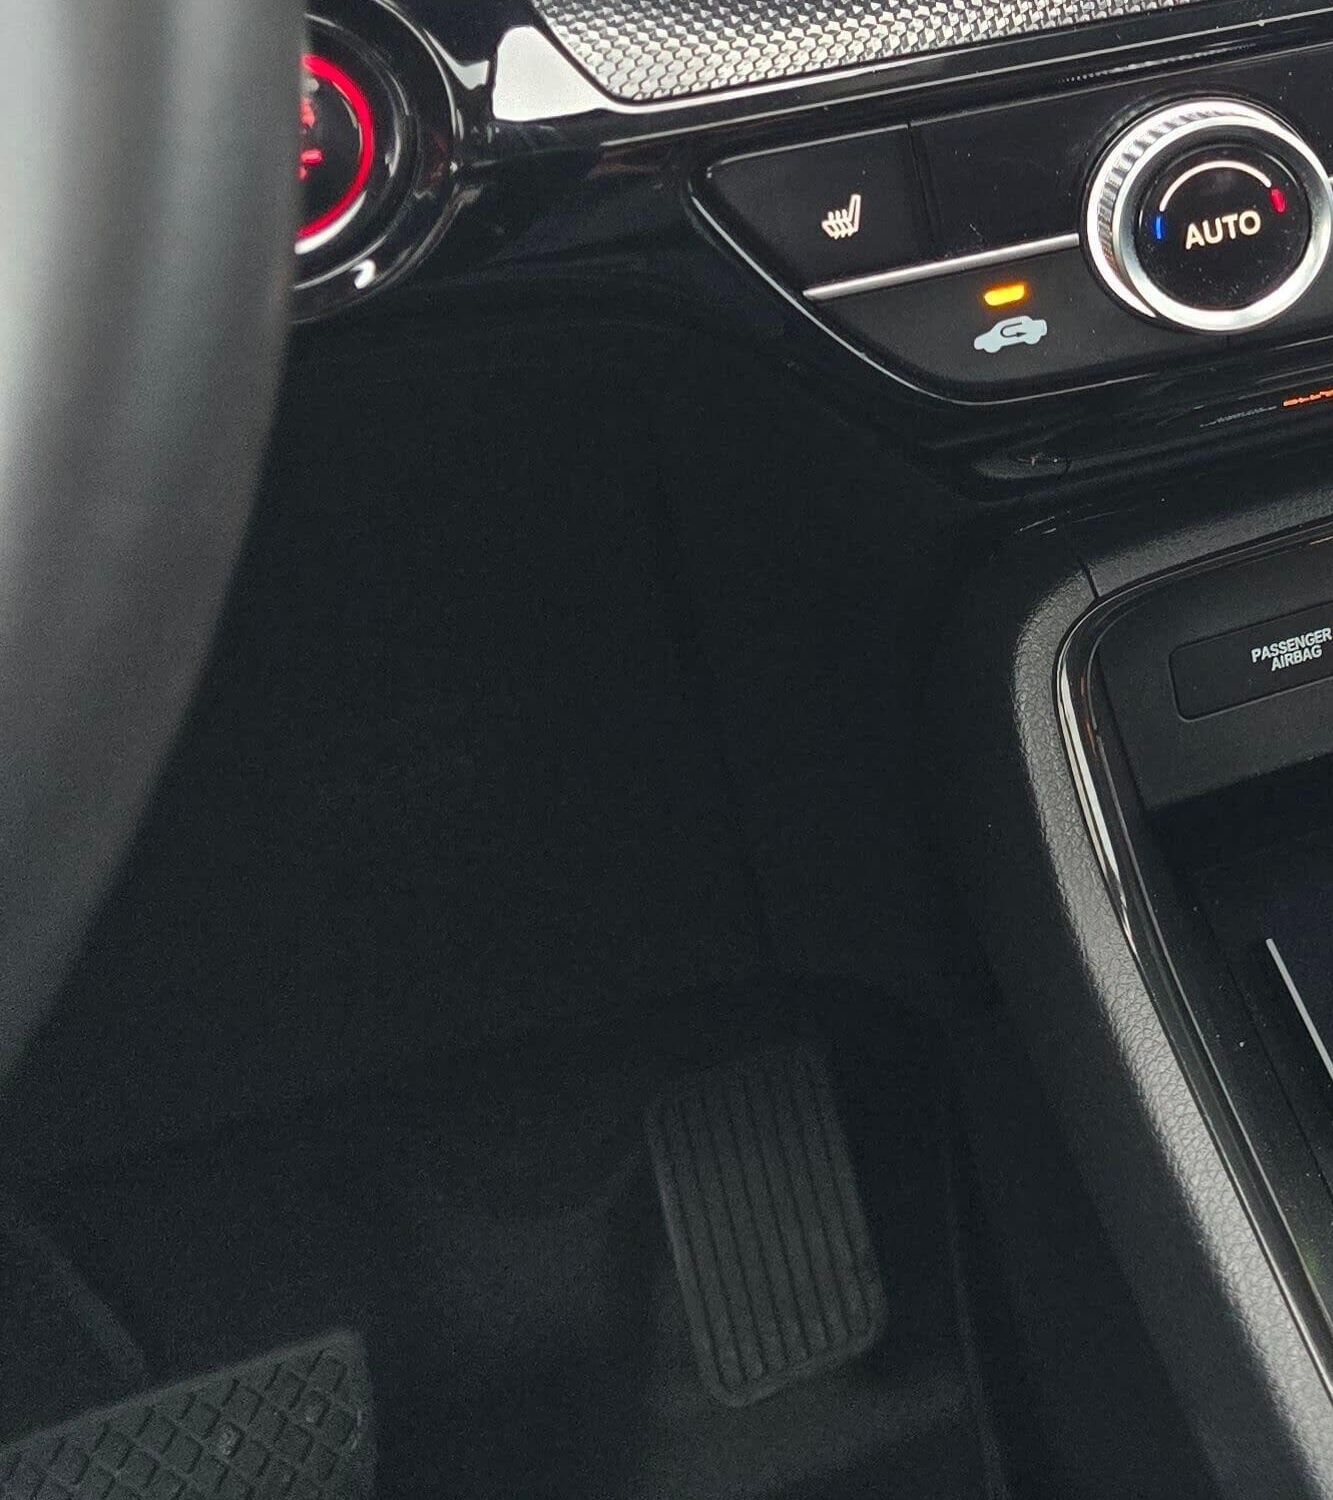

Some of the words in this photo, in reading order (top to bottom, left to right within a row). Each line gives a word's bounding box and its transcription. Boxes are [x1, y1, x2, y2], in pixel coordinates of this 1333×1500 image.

[1185, 210, 1260, 249] AUTO
[1251, 627, 1332, 663] PASSENGER
[1271, 644, 1322, 672] AIRBAG
